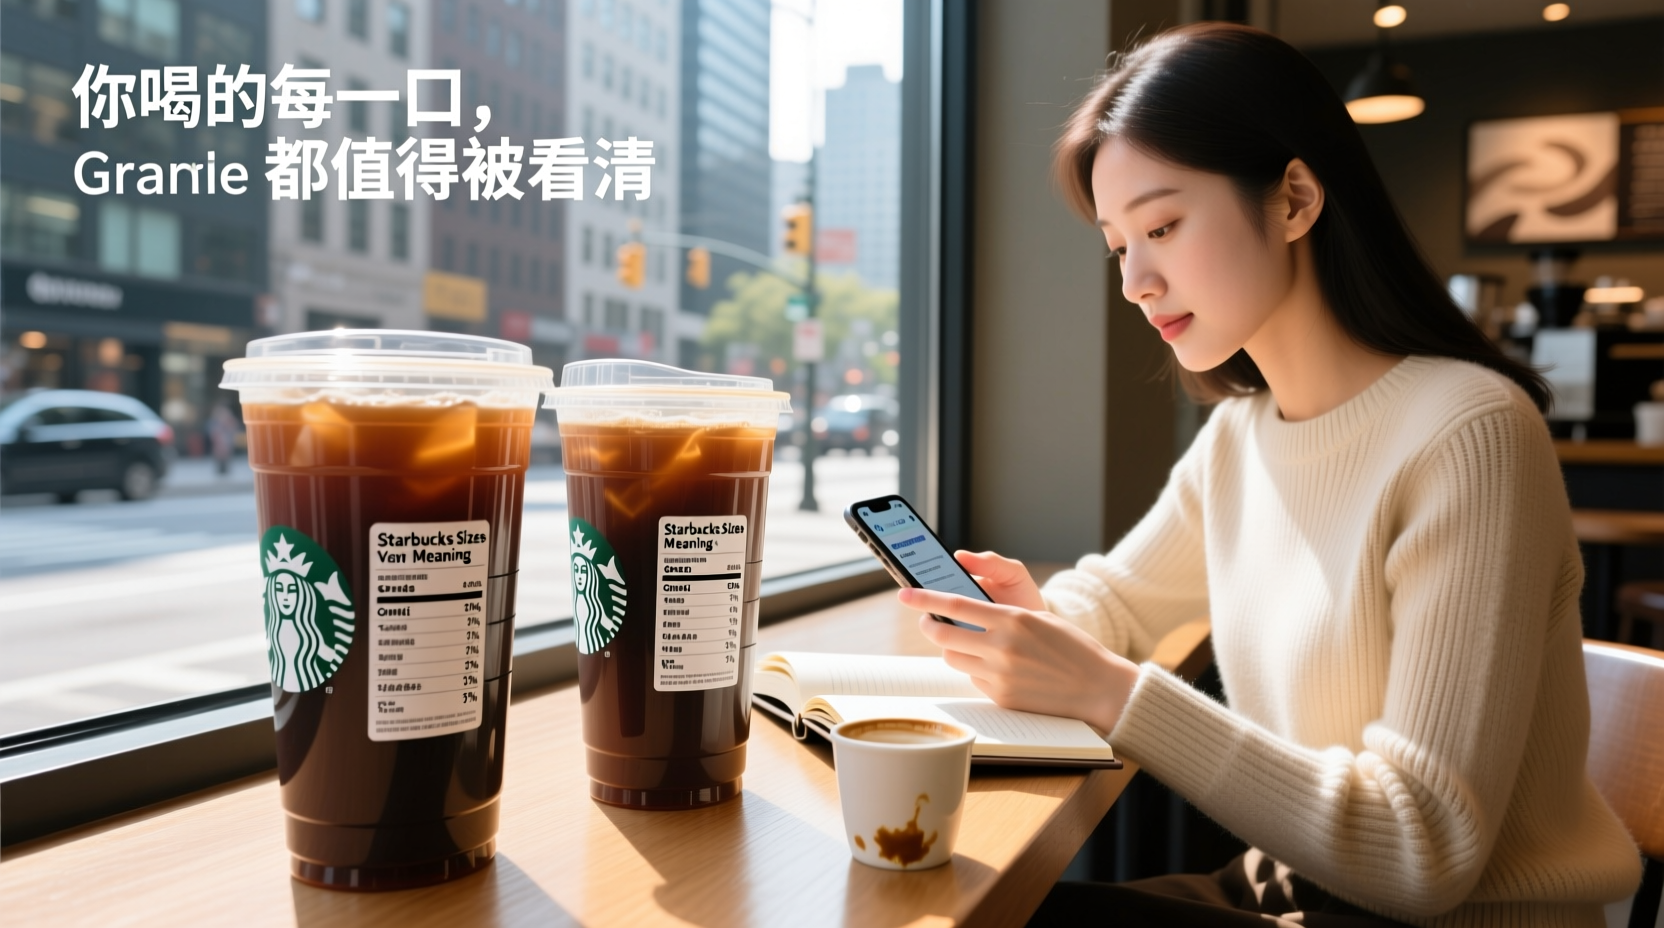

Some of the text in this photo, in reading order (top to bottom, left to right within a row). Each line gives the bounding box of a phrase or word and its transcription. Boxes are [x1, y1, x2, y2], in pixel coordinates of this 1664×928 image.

[664, 521, 720, 536] Starbucks
[377, 530, 454, 547] Starbucks
[412, 547, 472, 564] Meaning
